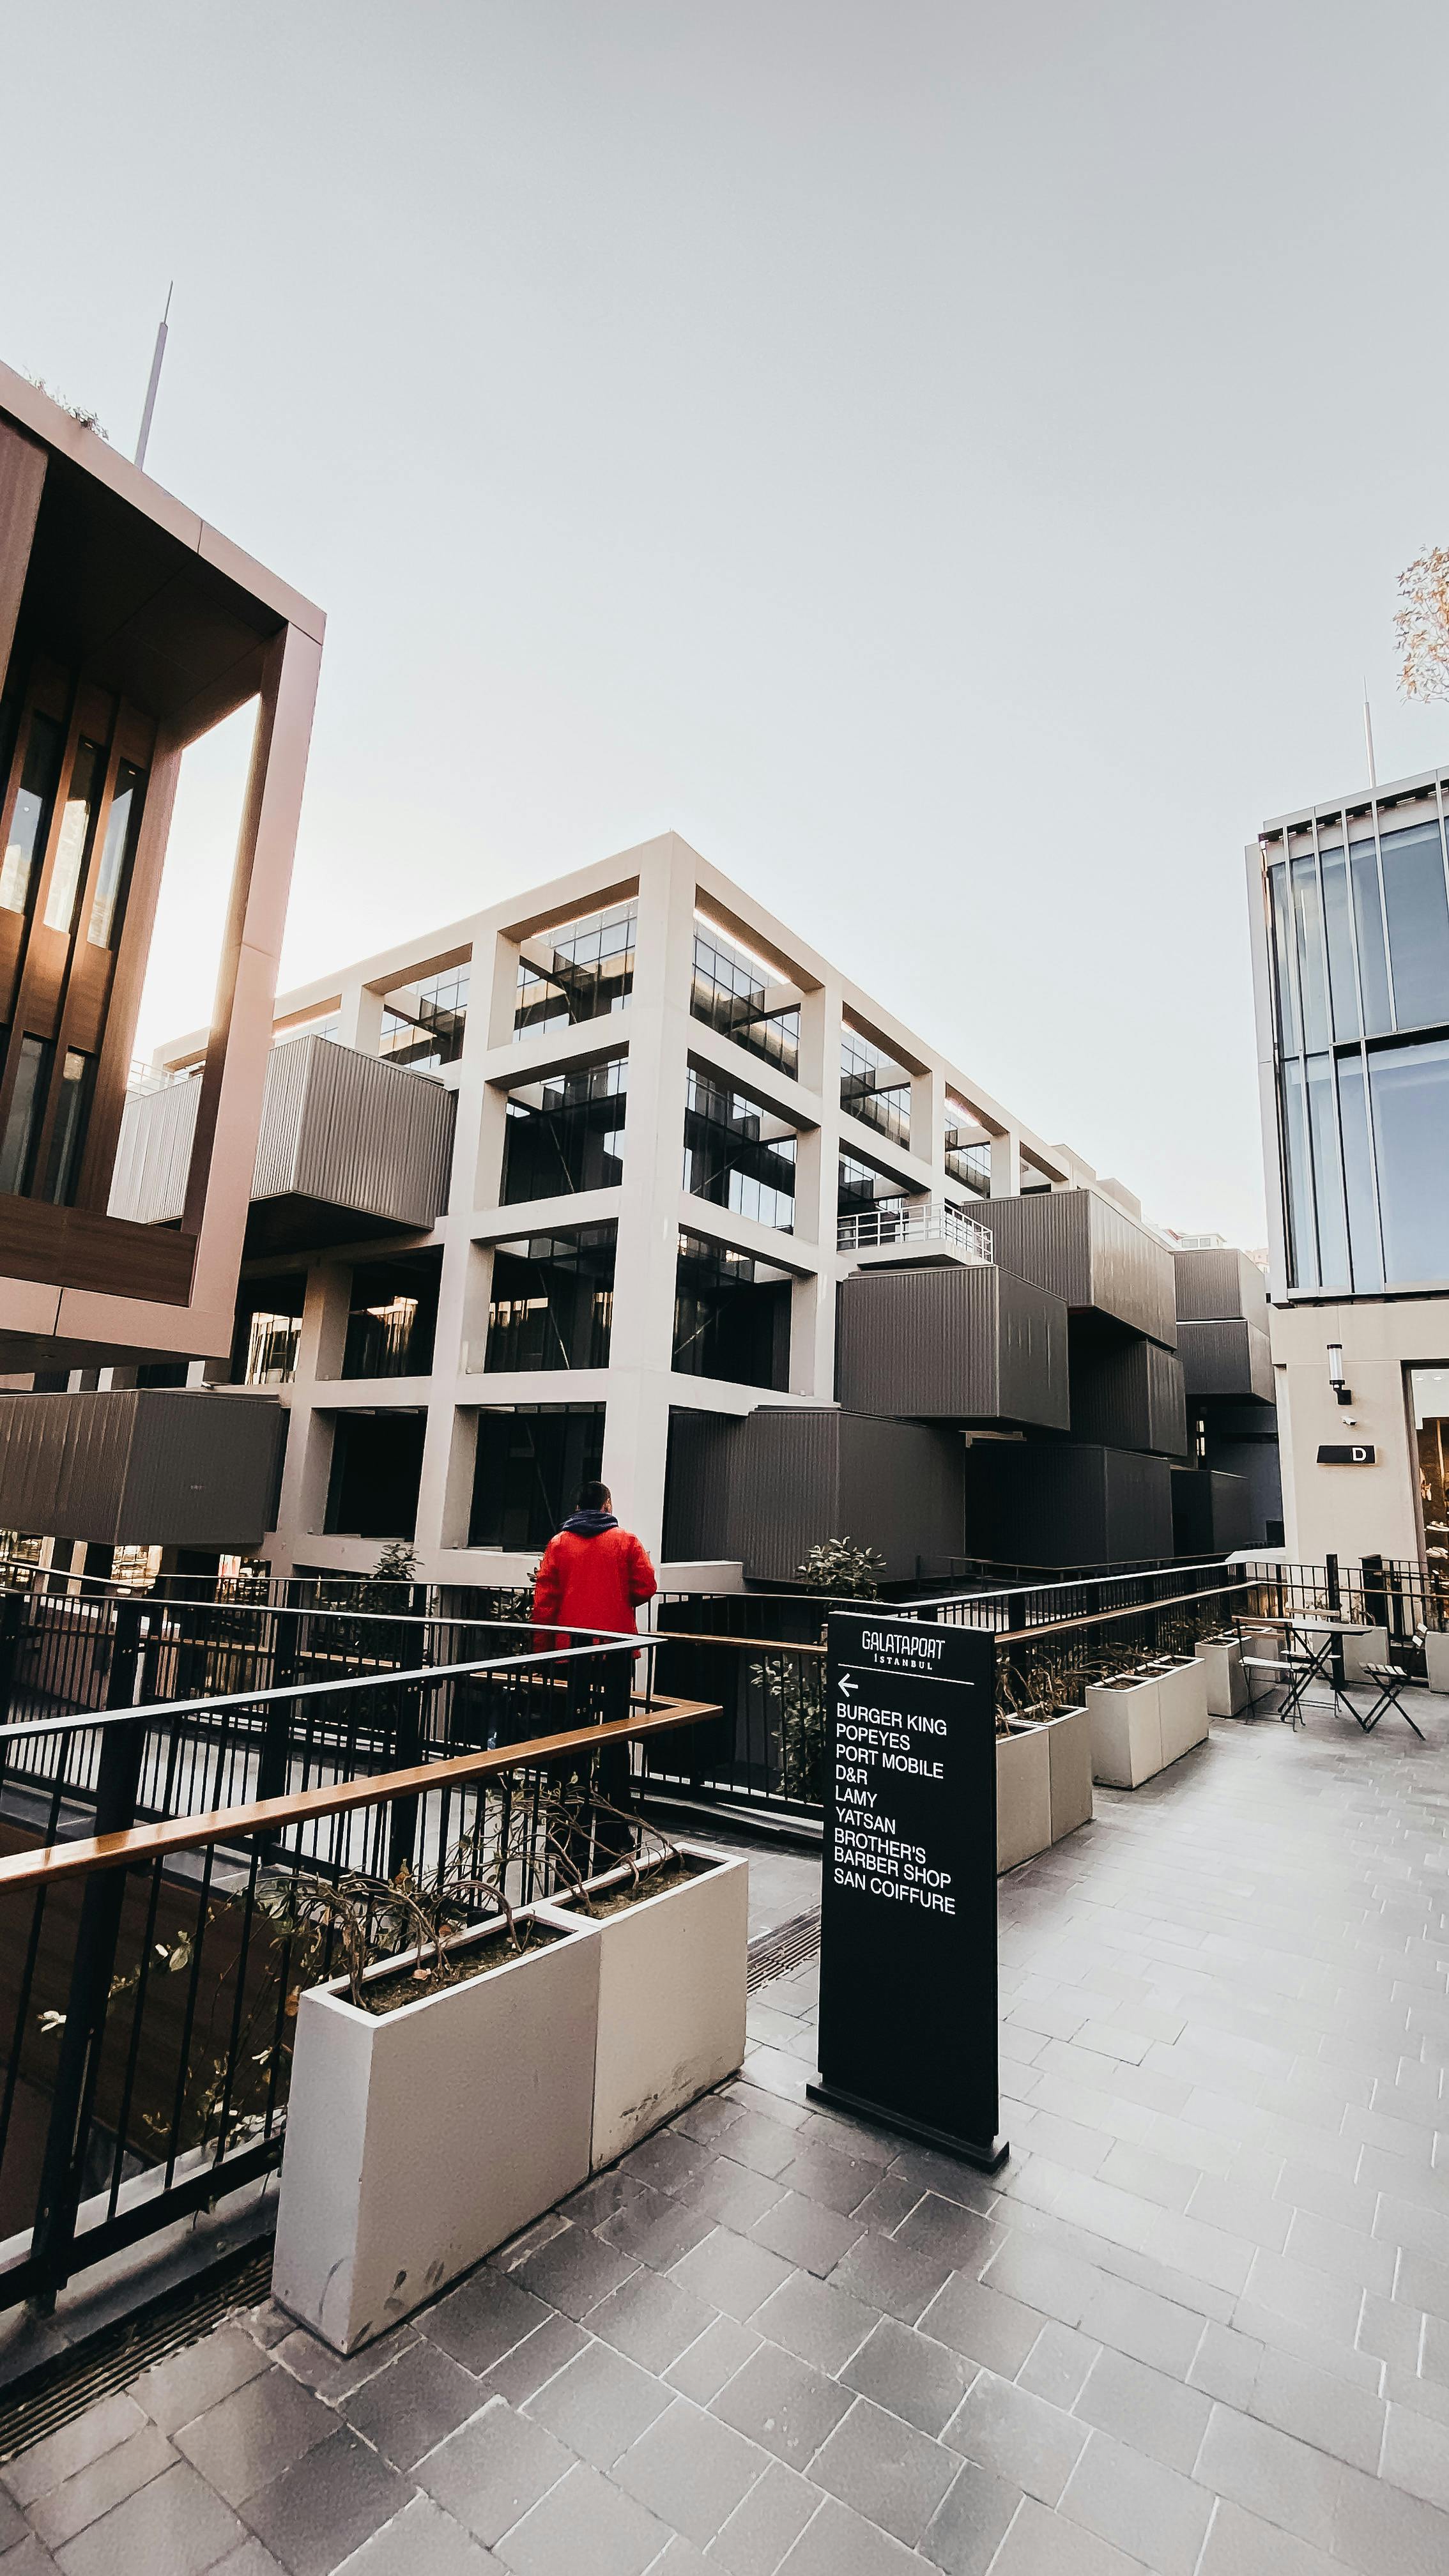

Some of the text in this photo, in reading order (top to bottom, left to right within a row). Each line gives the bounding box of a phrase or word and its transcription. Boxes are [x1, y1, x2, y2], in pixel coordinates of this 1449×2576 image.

[1352, 1447, 1367, 1461] D
[862, 1630, 946, 1660] GALATAPORT
[837, 1702, 947, 1736] BURGER KING
[836, 1722, 910, 1751] POPEYES
[836, 1744, 944, 1779] PORT MOBILE
[836, 1764, 868, 1785] D&R
[835, 1784, 878, 1808] LAMY
[835, 1806, 896, 1835] YATSAN
[834, 1827, 926, 1864] BROTHER'S
[834, 1845, 951, 1889] BARBER SHOP
[834, 1867, 956, 1915] SAN COIFFURE
